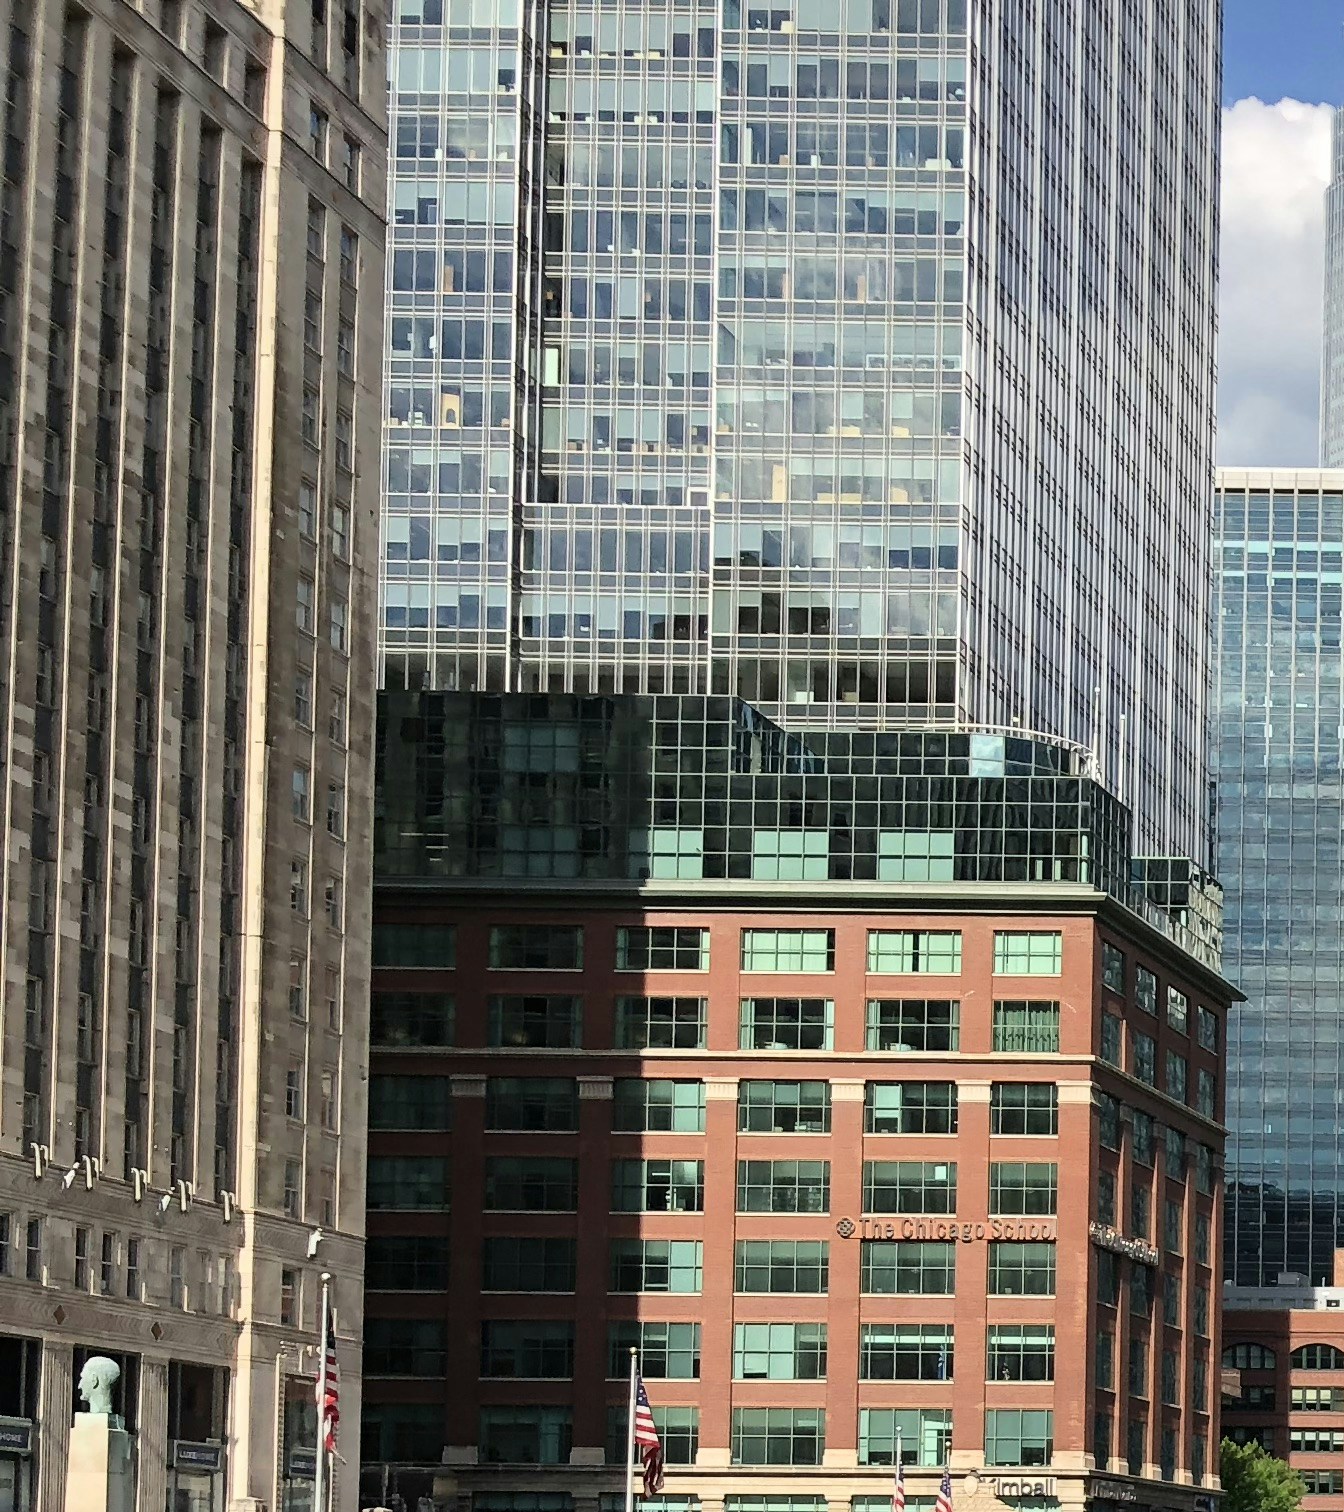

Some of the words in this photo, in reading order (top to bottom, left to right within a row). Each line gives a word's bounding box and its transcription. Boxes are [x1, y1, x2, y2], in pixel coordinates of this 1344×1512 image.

[859, 1218, 894, 1239] The
[901, 1217, 985, 1242] Chicago
[991, 1219, 1058, 1240] School
